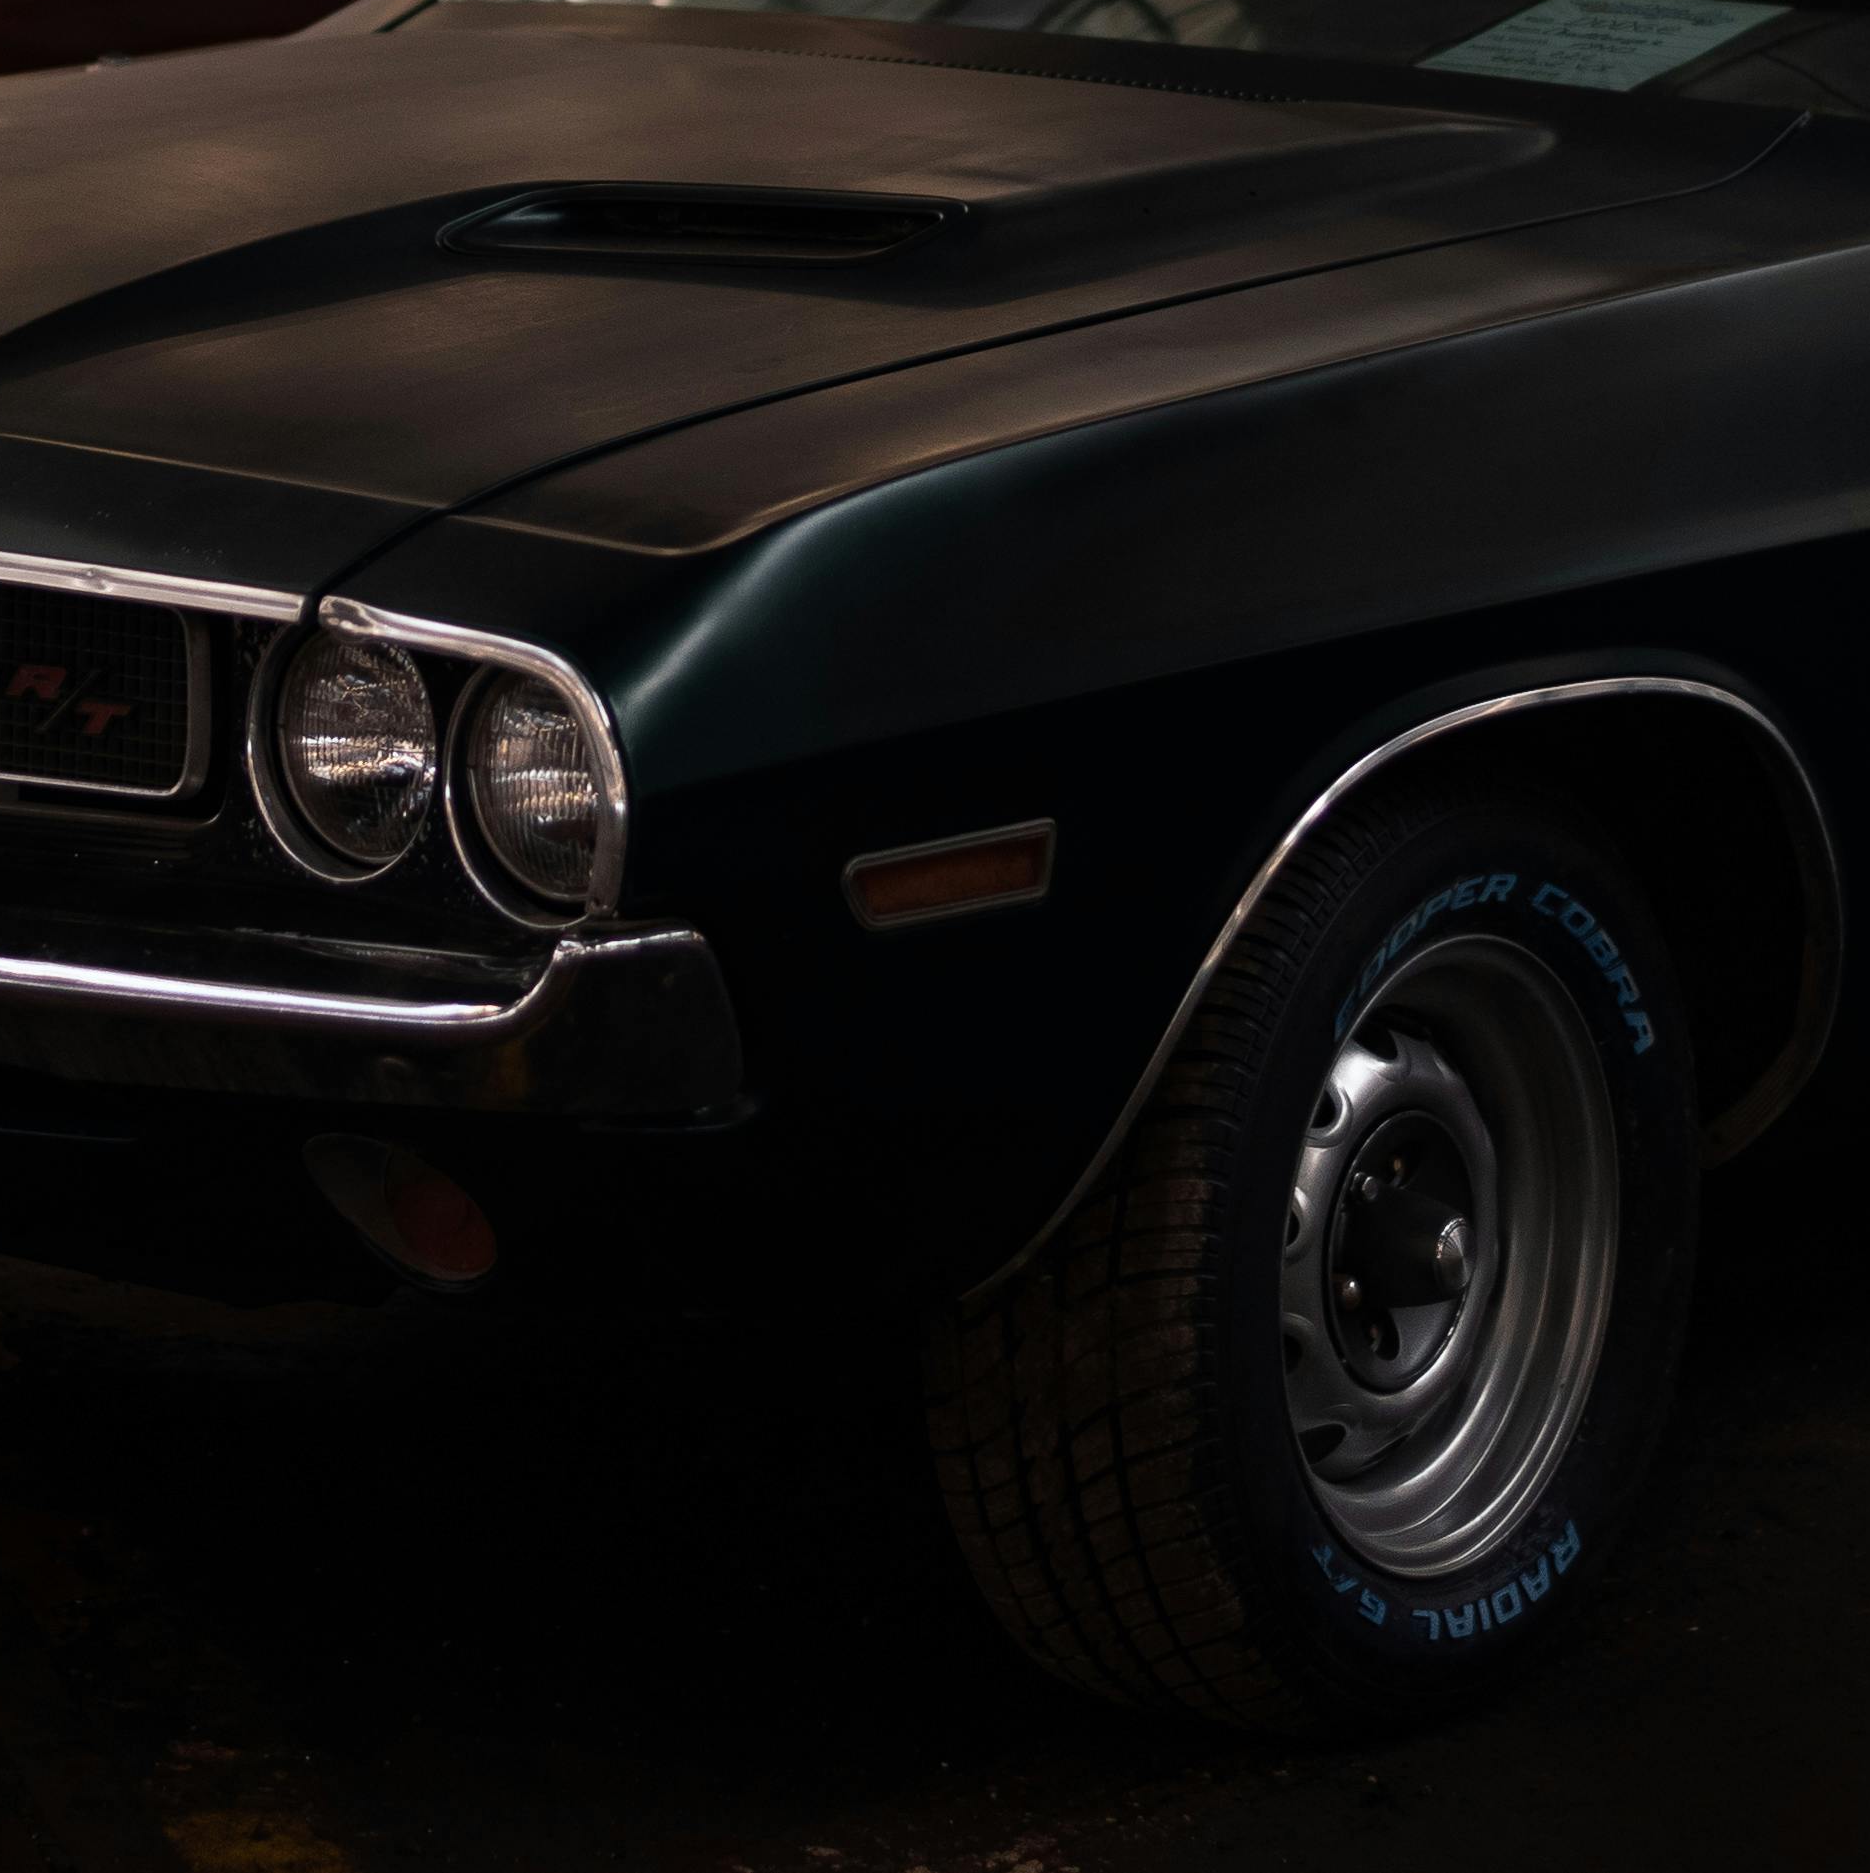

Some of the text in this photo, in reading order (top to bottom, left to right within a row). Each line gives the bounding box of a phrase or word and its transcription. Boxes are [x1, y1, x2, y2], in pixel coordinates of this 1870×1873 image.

[4, 664, 132, 736] R/T
[1333, 872, 1657, 1056] COOPER COBRA
[1410, 1518, 1582, 1641] RADIAL
